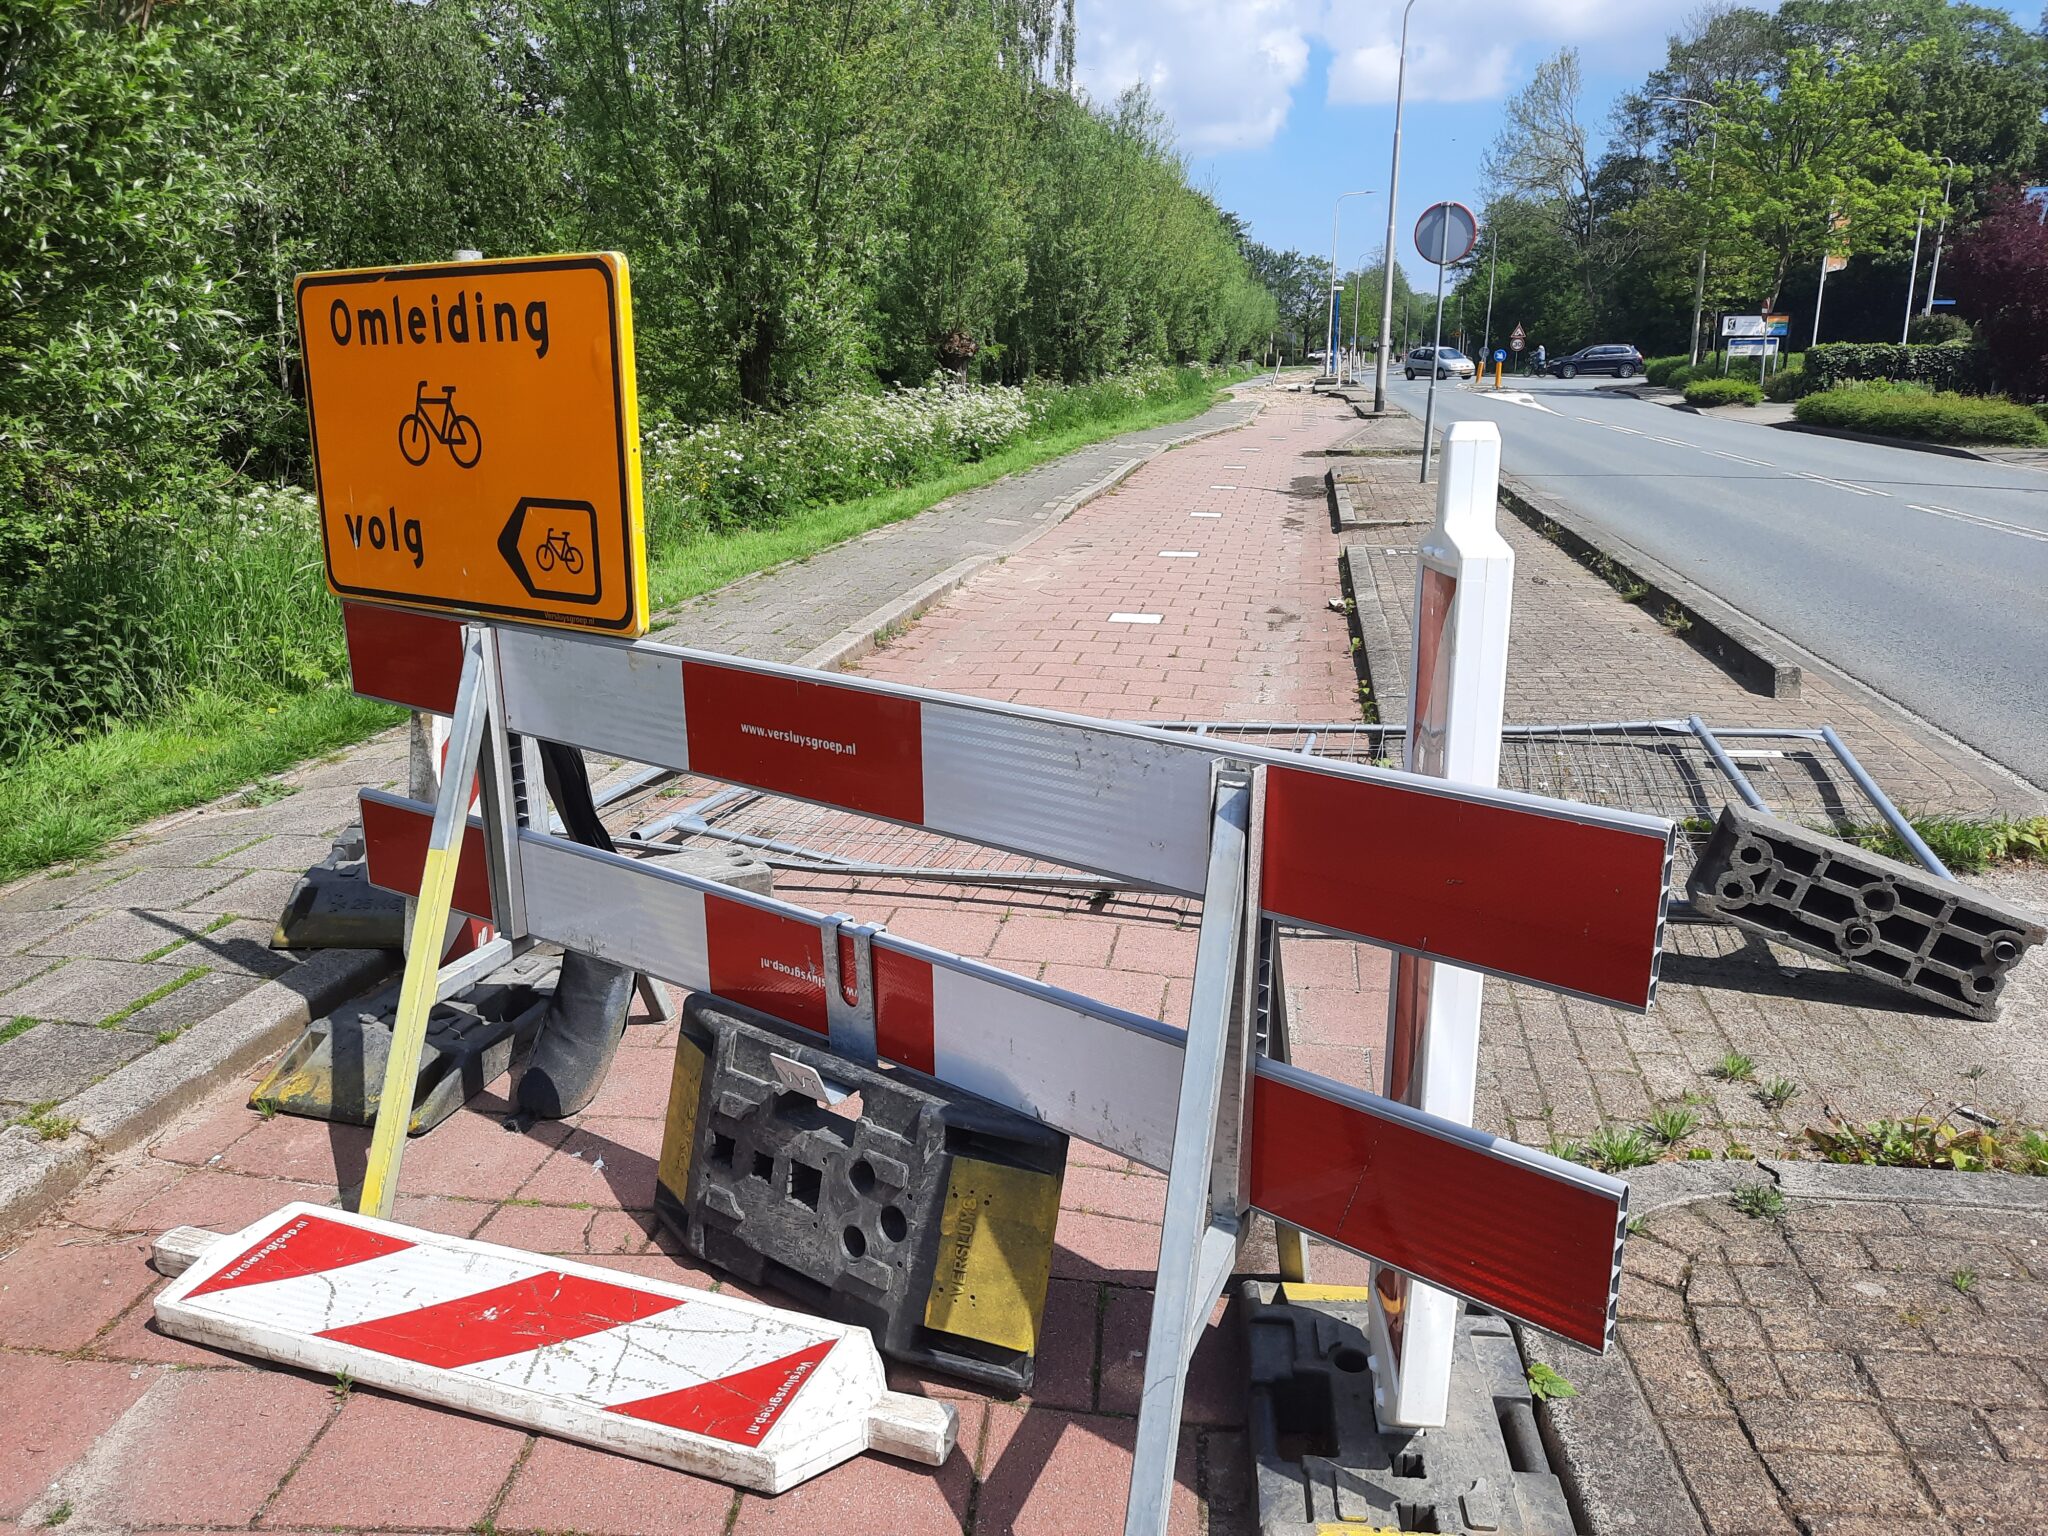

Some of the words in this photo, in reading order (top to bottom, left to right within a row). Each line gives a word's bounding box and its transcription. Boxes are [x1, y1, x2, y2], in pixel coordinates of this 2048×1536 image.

[330, 290, 550, 360] Omleiding
[344, 506, 424, 569] volg
[740, 722, 857, 756] www.versluysgroep.nl
[220, 1220, 310, 1280] Versluysgroep.nl
[745, 1360, 815, 1435] Versluysgroep.nl
